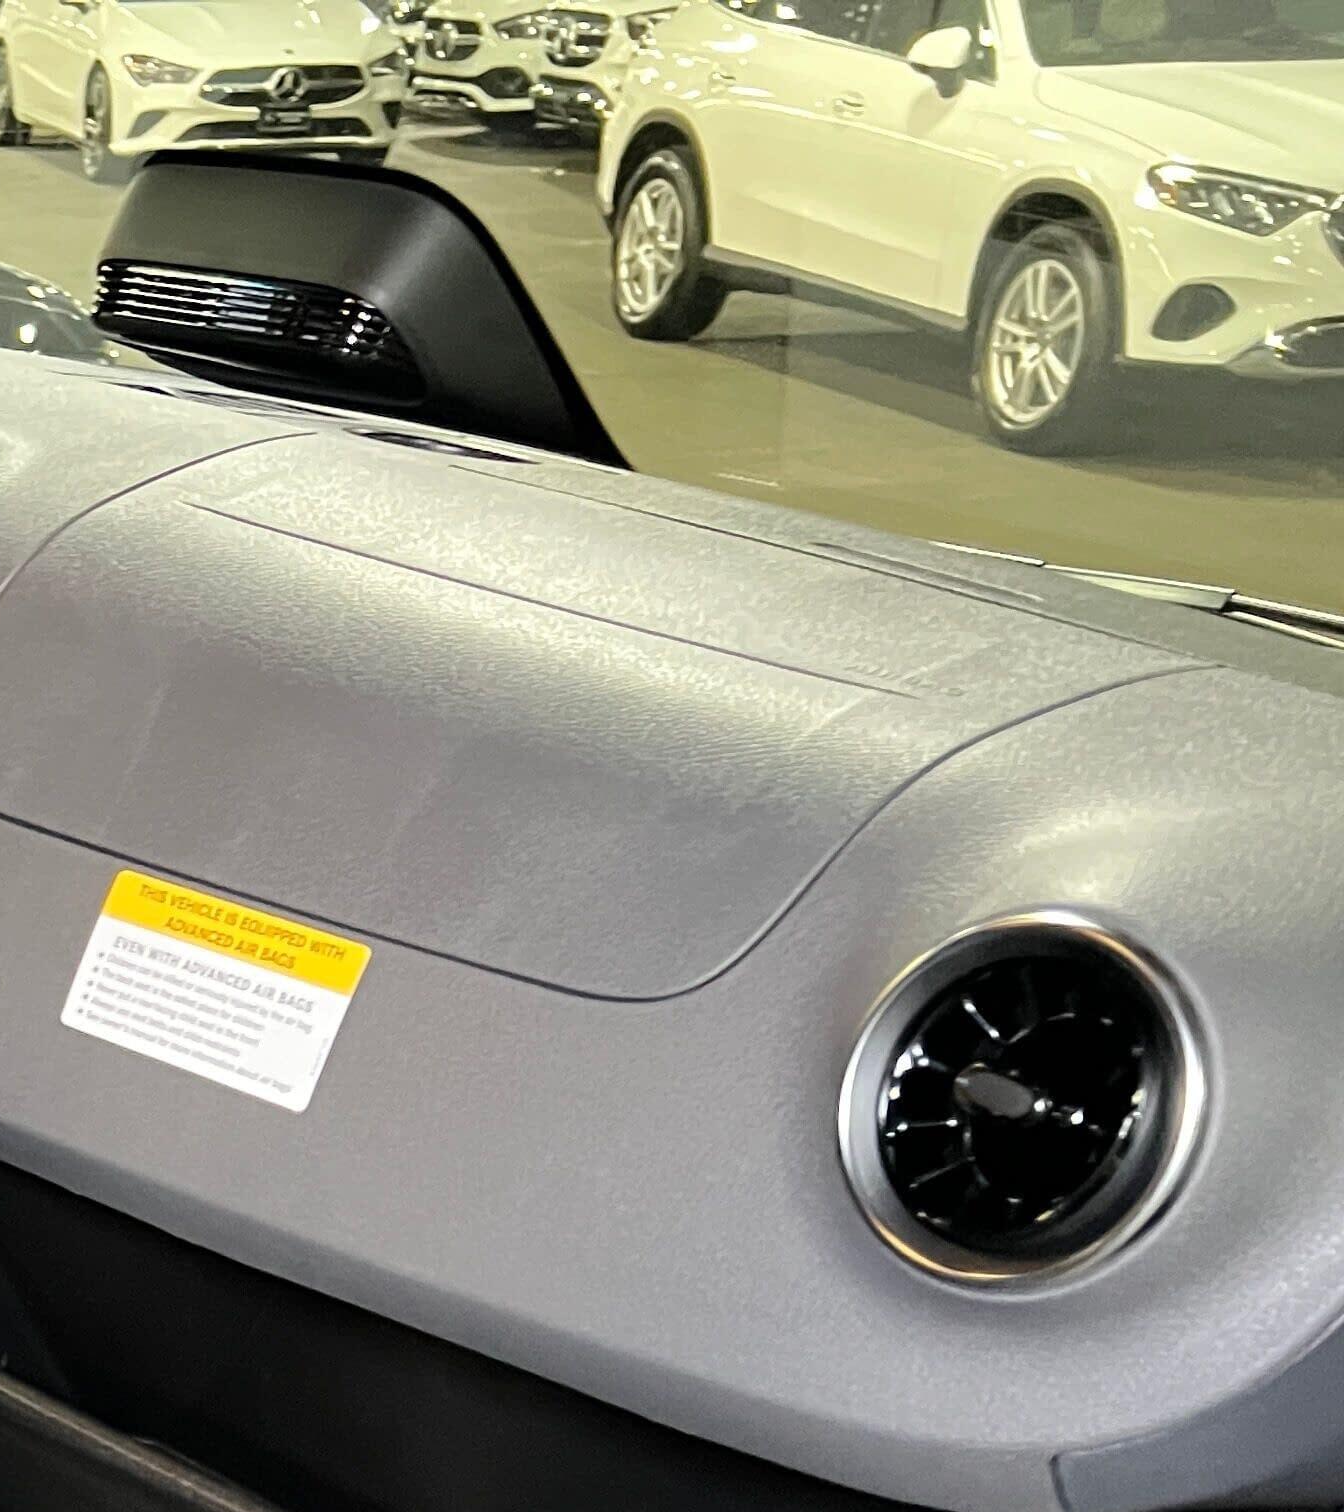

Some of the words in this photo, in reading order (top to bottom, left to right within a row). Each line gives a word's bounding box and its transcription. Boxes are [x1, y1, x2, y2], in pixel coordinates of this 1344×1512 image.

[138, 883, 169, 904] THIS
[168, 892, 224, 922] VEHICLE
[222, 910, 240, 927] IS
[238, 915, 308, 949] EQUIPPED
[307, 937, 347, 962] WITH
[164, 915, 235, 949] ADVANCED
[233, 938, 260, 958] AIR
[259, 946, 297, 970] BAGS
[112, 934, 146, 956] EVEN
[146, 946, 181, 969] WITH
[180, 958, 252, 992] ADVANCED
[250, 982, 277, 1001] AIR
[276, 991, 315, 1014] BAGS
